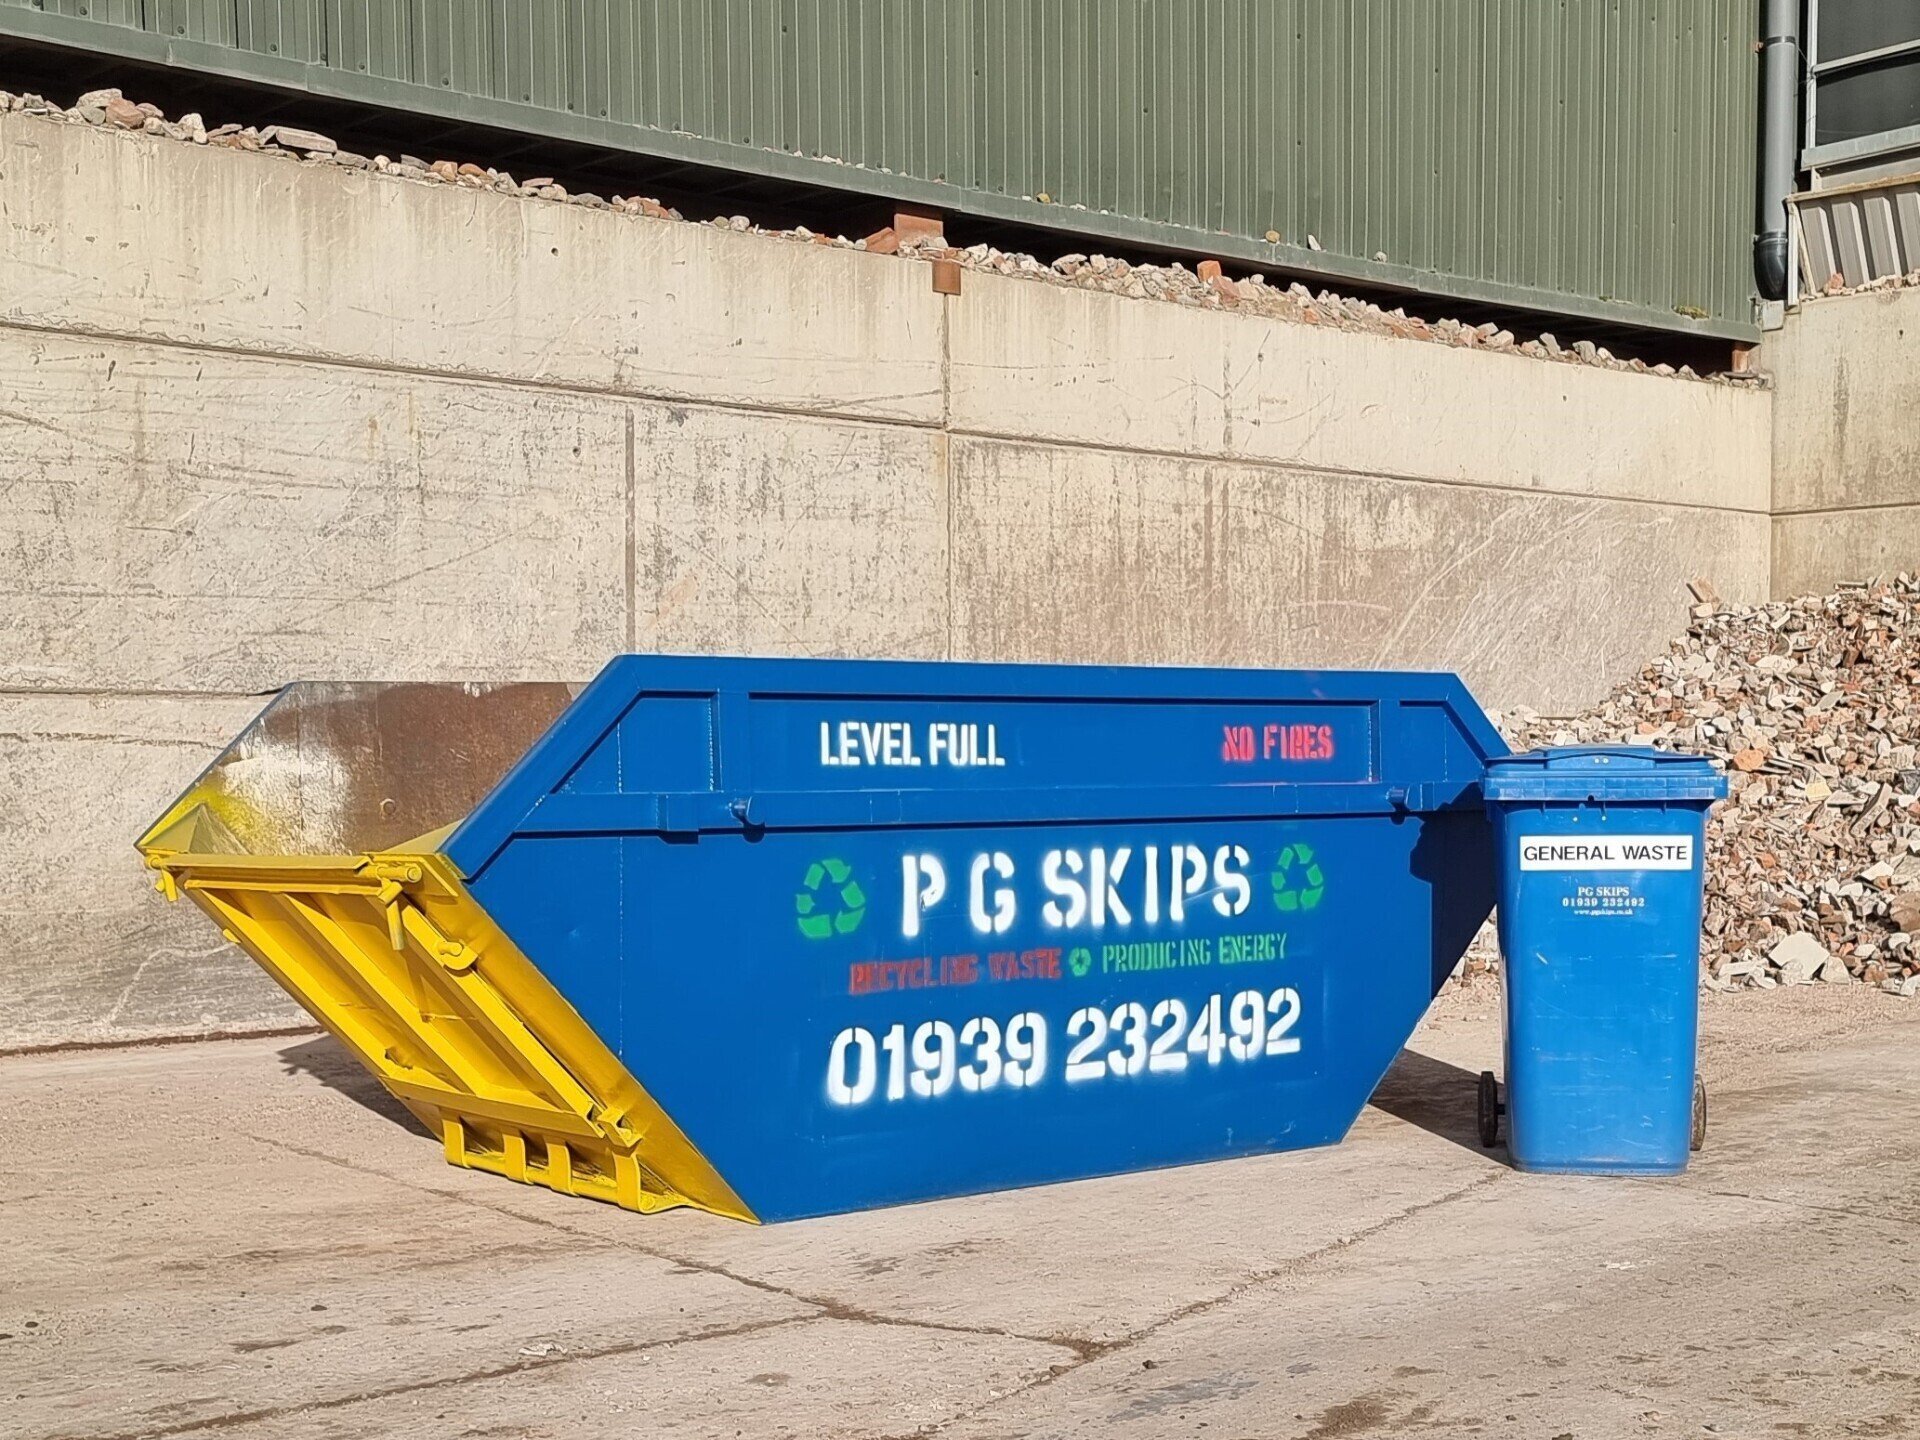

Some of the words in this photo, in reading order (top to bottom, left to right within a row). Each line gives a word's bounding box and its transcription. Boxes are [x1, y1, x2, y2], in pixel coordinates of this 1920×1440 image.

[820, 721, 921, 767] LEVEL
[929, 723, 1007, 769] FULL
[1222, 725, 1255, 762] NO
[1263, 723, 1336, 761] FIRES
[1523, 845, 1615, 861] GENERAL
[1622, 845, 1688, 860] WASTE
[1042, 843, 1253, 929] SKIPS
[1562, 898, 1599, 907] 01939
[1602, 898, 1645, 907] 232492
[1577, 886, 1594, 897] PG
[1596, 886, 1630, 896] SKIPS
[848, 951, 980, 995] RECYCLING
[989, 948, 1063, 981] WASTE
[1102, 938, 1211, 974] PRODUCING
[1219, 932, 1288, 966] ENERGY
[826, 1012, 1047, 1106] 01939
[1065, 987, 1302, 1083] 232492
